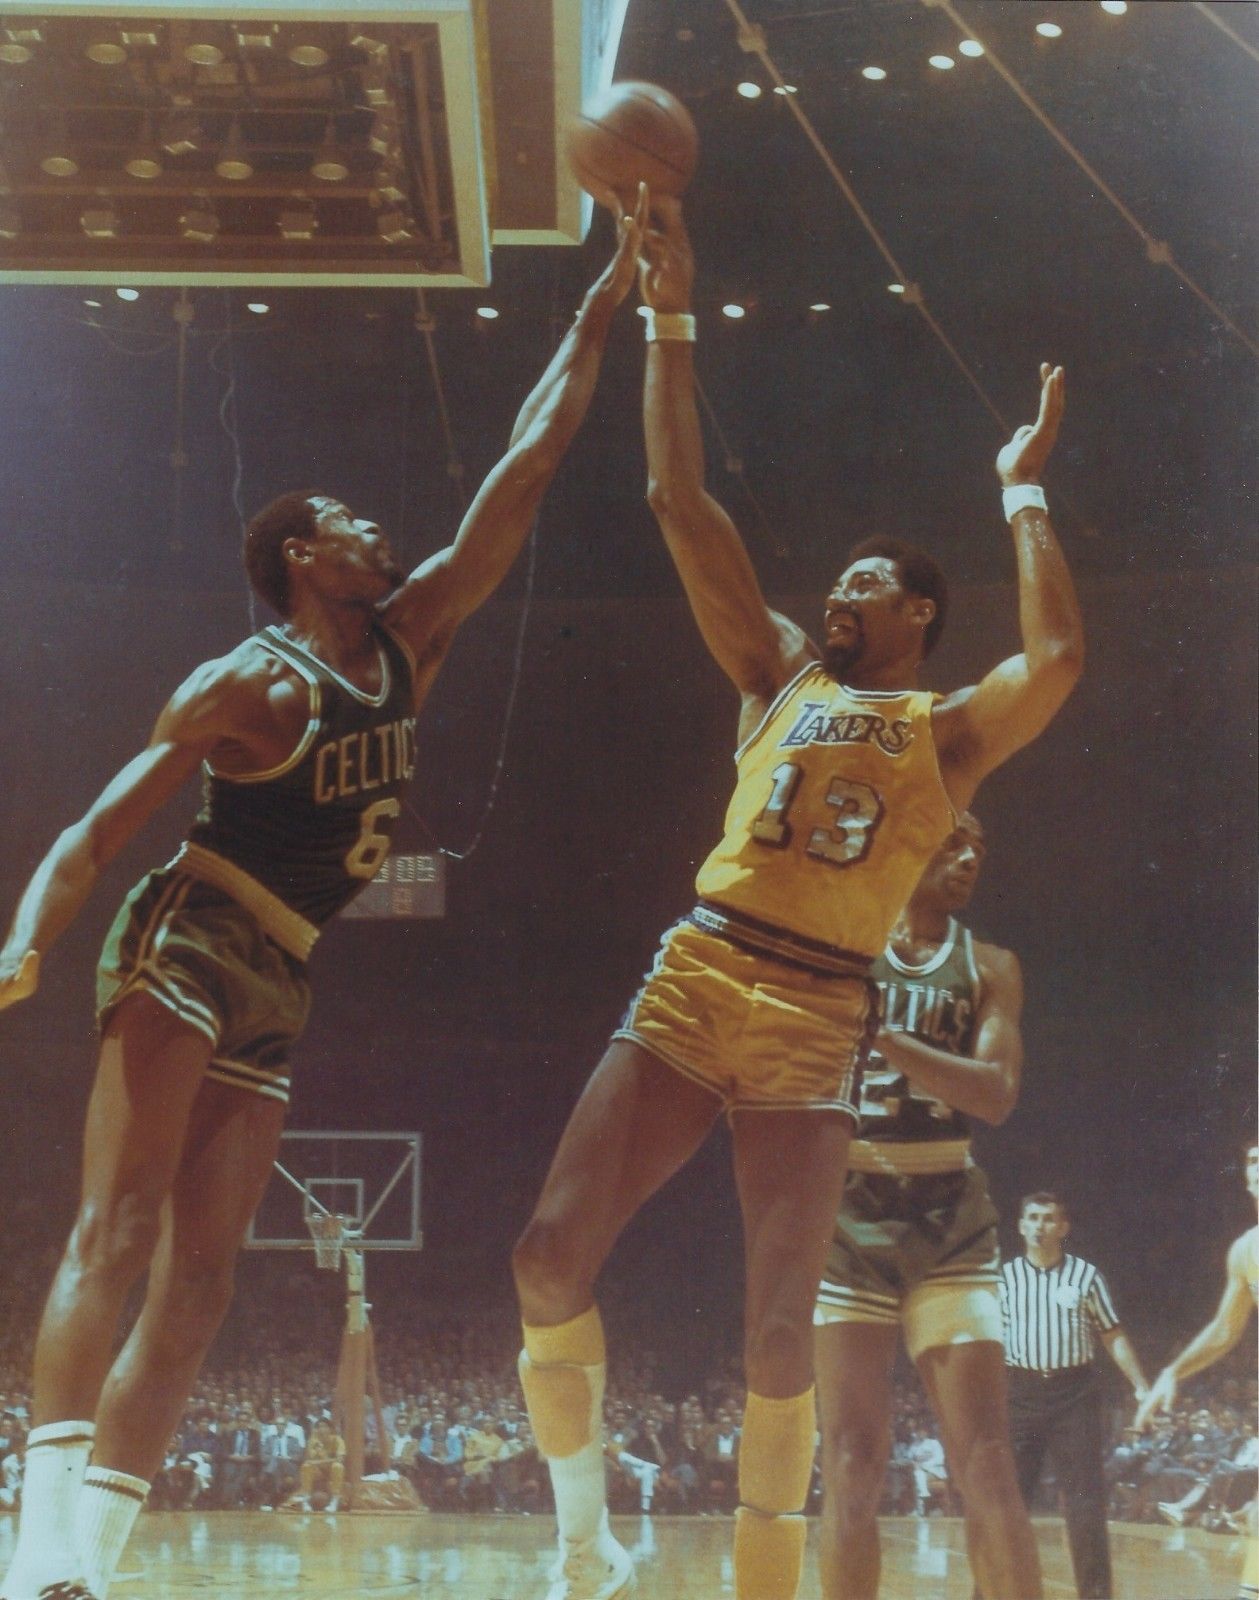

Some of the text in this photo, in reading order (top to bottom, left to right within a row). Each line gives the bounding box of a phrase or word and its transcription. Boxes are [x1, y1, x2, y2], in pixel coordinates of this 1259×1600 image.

[780, 703, 912, 756] LAKERS
[345, 798, 400, 878] 6
[753, 762, 885, 867] 13
